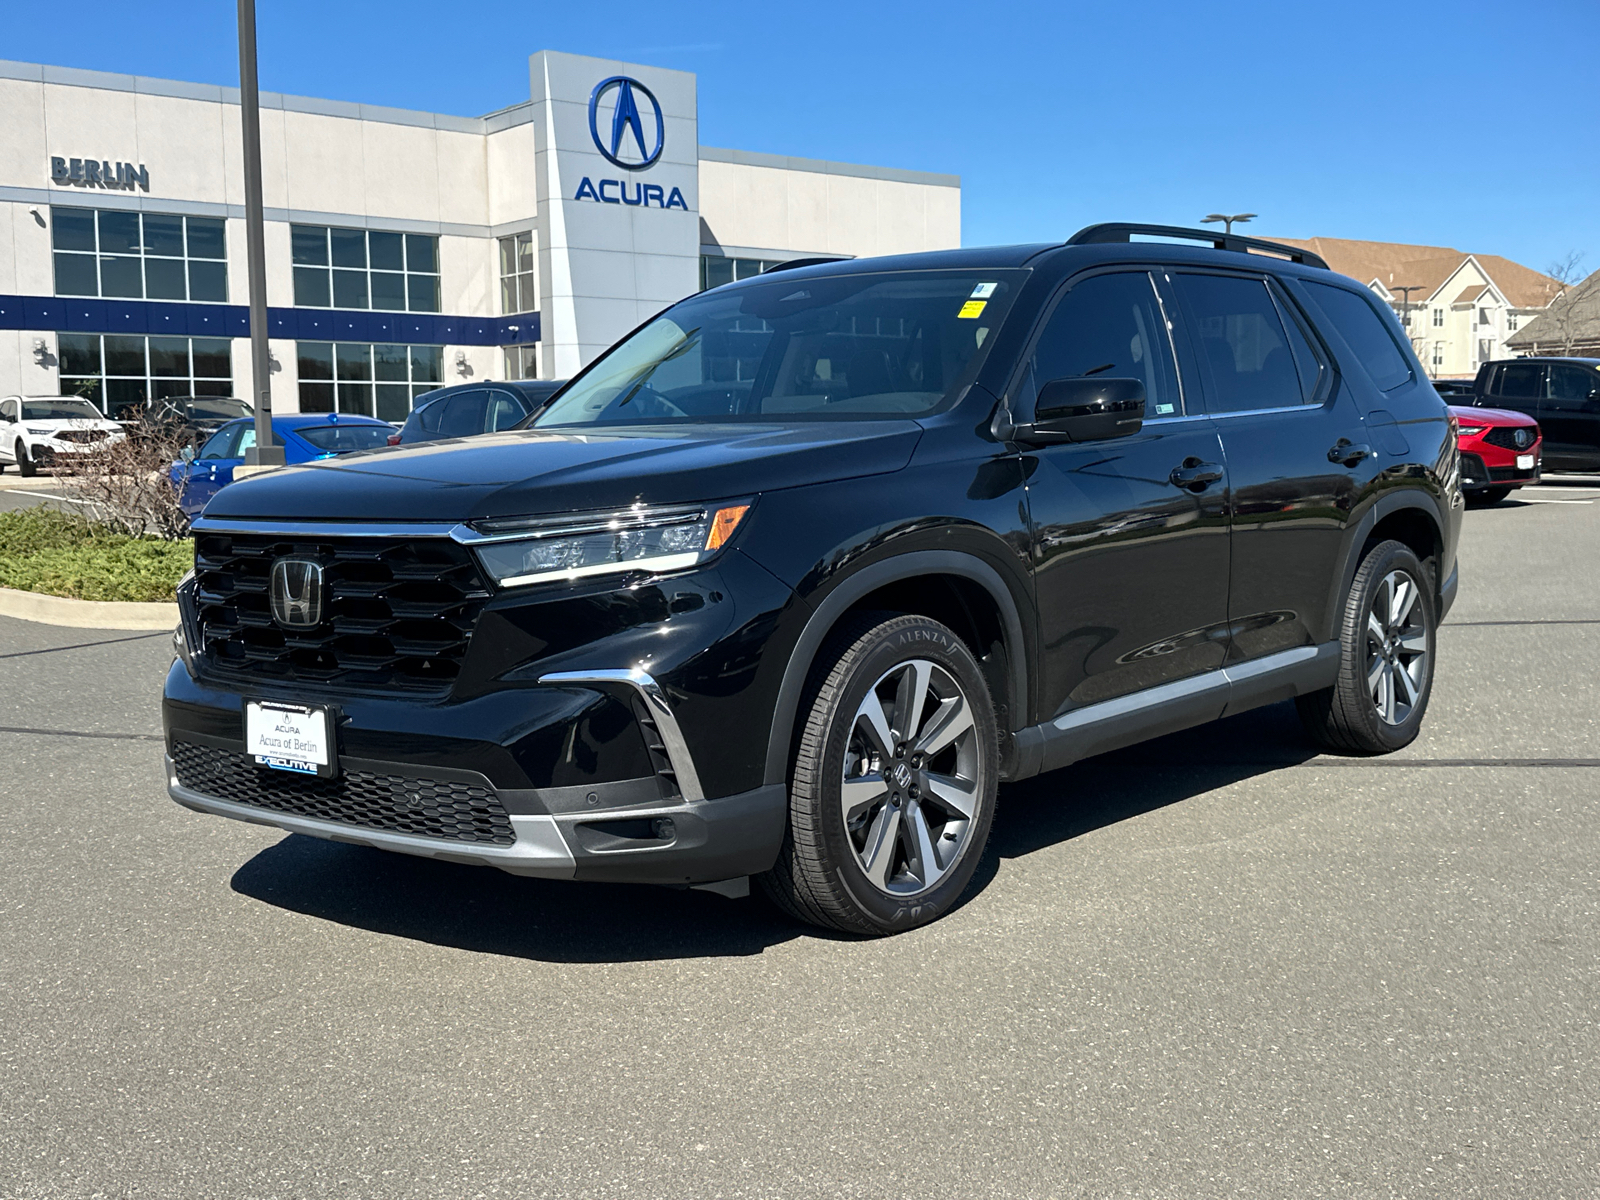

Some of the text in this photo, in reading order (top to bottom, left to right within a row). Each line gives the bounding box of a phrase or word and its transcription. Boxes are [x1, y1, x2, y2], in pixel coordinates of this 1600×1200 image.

[51, 156, 146, 186] BERLIN
[574, 176, 689, 211] ACURA
[899, 629, 948, 647] ALENZA
[274, 724, 301, 735] ACURA
[259, 733, 318, 753] Acura of Berlin
[255, 755, 318, 772] EXECUTIVE
